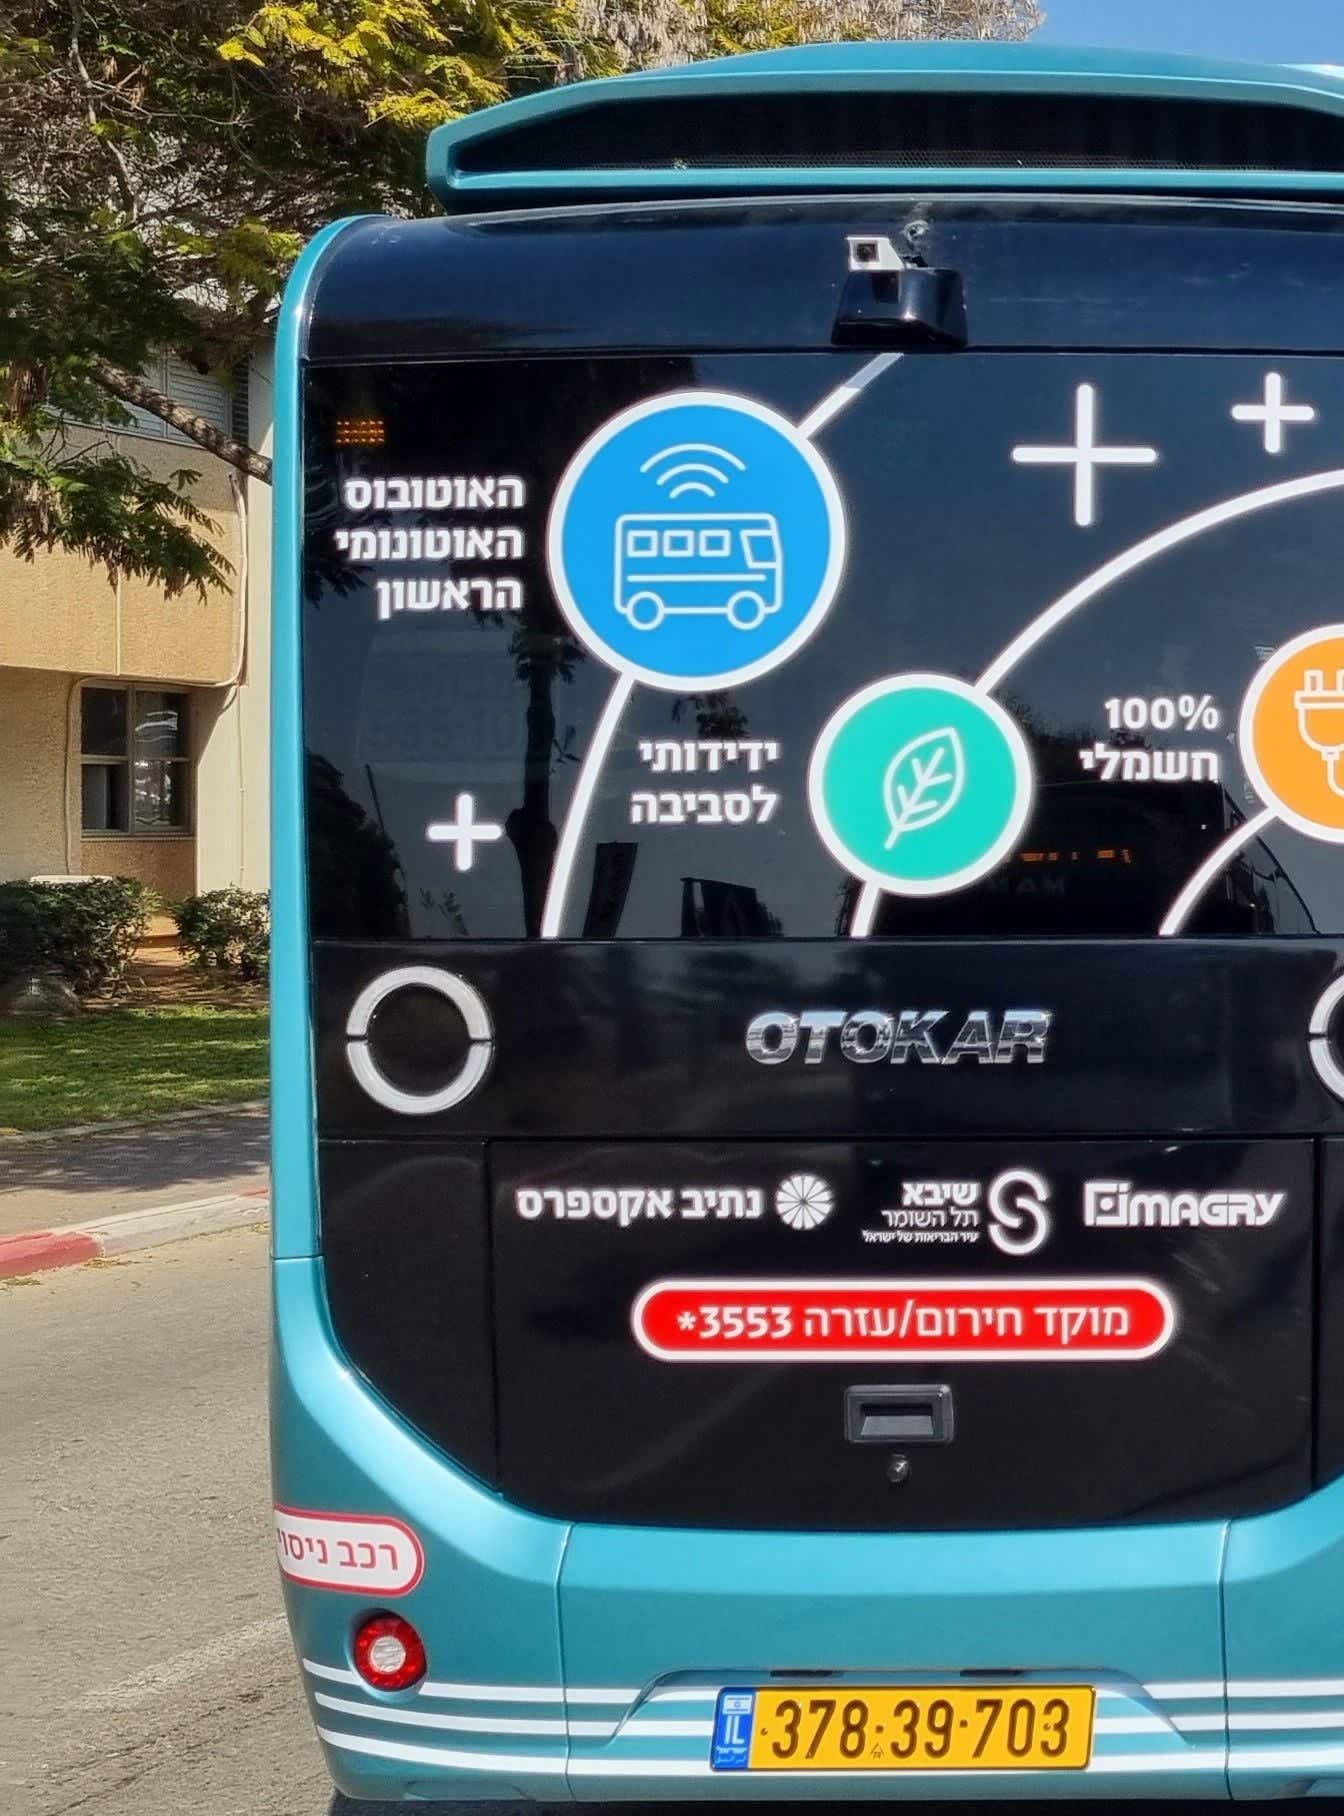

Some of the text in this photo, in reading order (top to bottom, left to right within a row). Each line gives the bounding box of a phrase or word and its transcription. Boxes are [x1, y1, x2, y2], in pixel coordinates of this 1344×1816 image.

[344, 477, 525, 511] האוטובוס
[334, 527, 524, 561] האוטונומי
[376, 578, 524, 620] הראשון
[1105, 696, 1219, 732] 100%
[638, 739, 779, 773] ידידותי
[1079, 742, 1219, 782] חשמלי
[630, 786, 778, 824] לסביבה
[744, 1008, 1052, 1066] OTOKAR
[516, 1187, 762, 1227] נתיב אקספרס
[902, 1182, 981, 1207] שיבא
[881, 1206, 979, 1228] תל השומר
[804, 1300, 1022, 1340] חירום/עזרה
[1034, 1306, 1129, 1344] מוקד
[336, 1540, 399, 1571] רכב
[724, 1714, 745, 1745] IL
